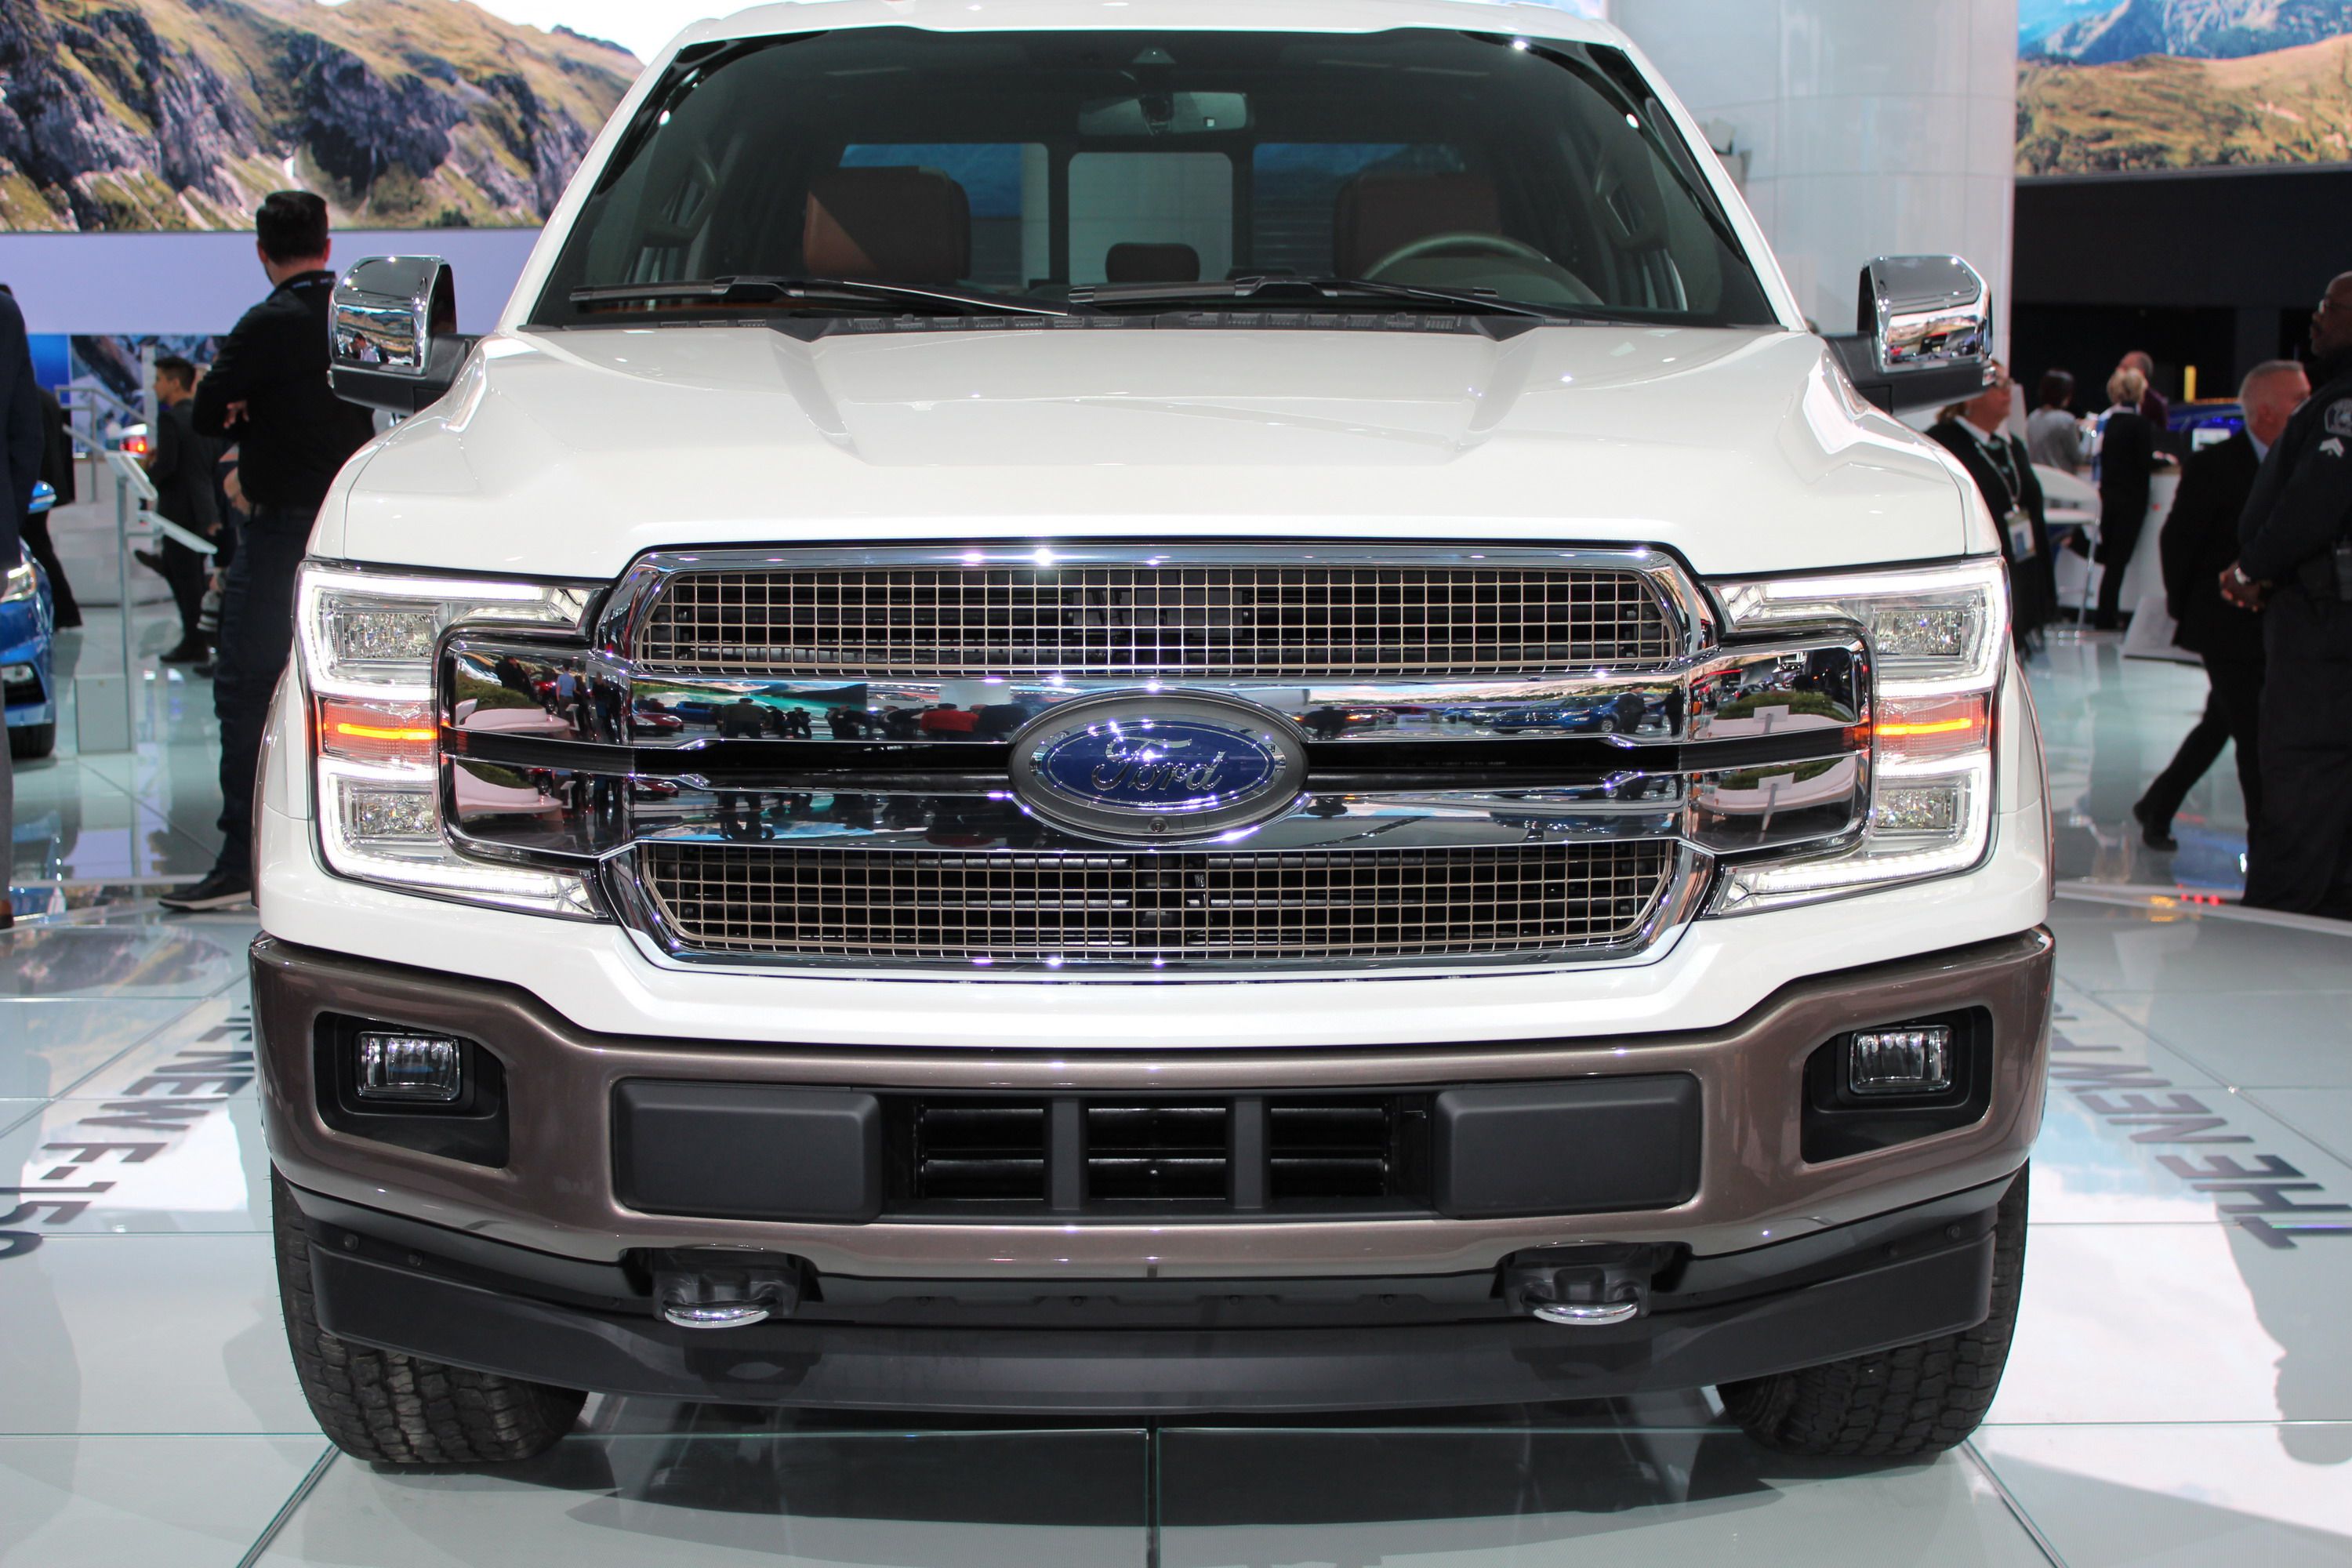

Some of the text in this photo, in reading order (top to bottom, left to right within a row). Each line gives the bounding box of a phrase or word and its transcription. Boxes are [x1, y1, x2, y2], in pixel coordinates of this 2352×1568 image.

[1091, 735, 1225, 791] Ford
[78, 1051, 255, 1131] NEW
[2049, 1062, 2352, 1250] THE NEW
